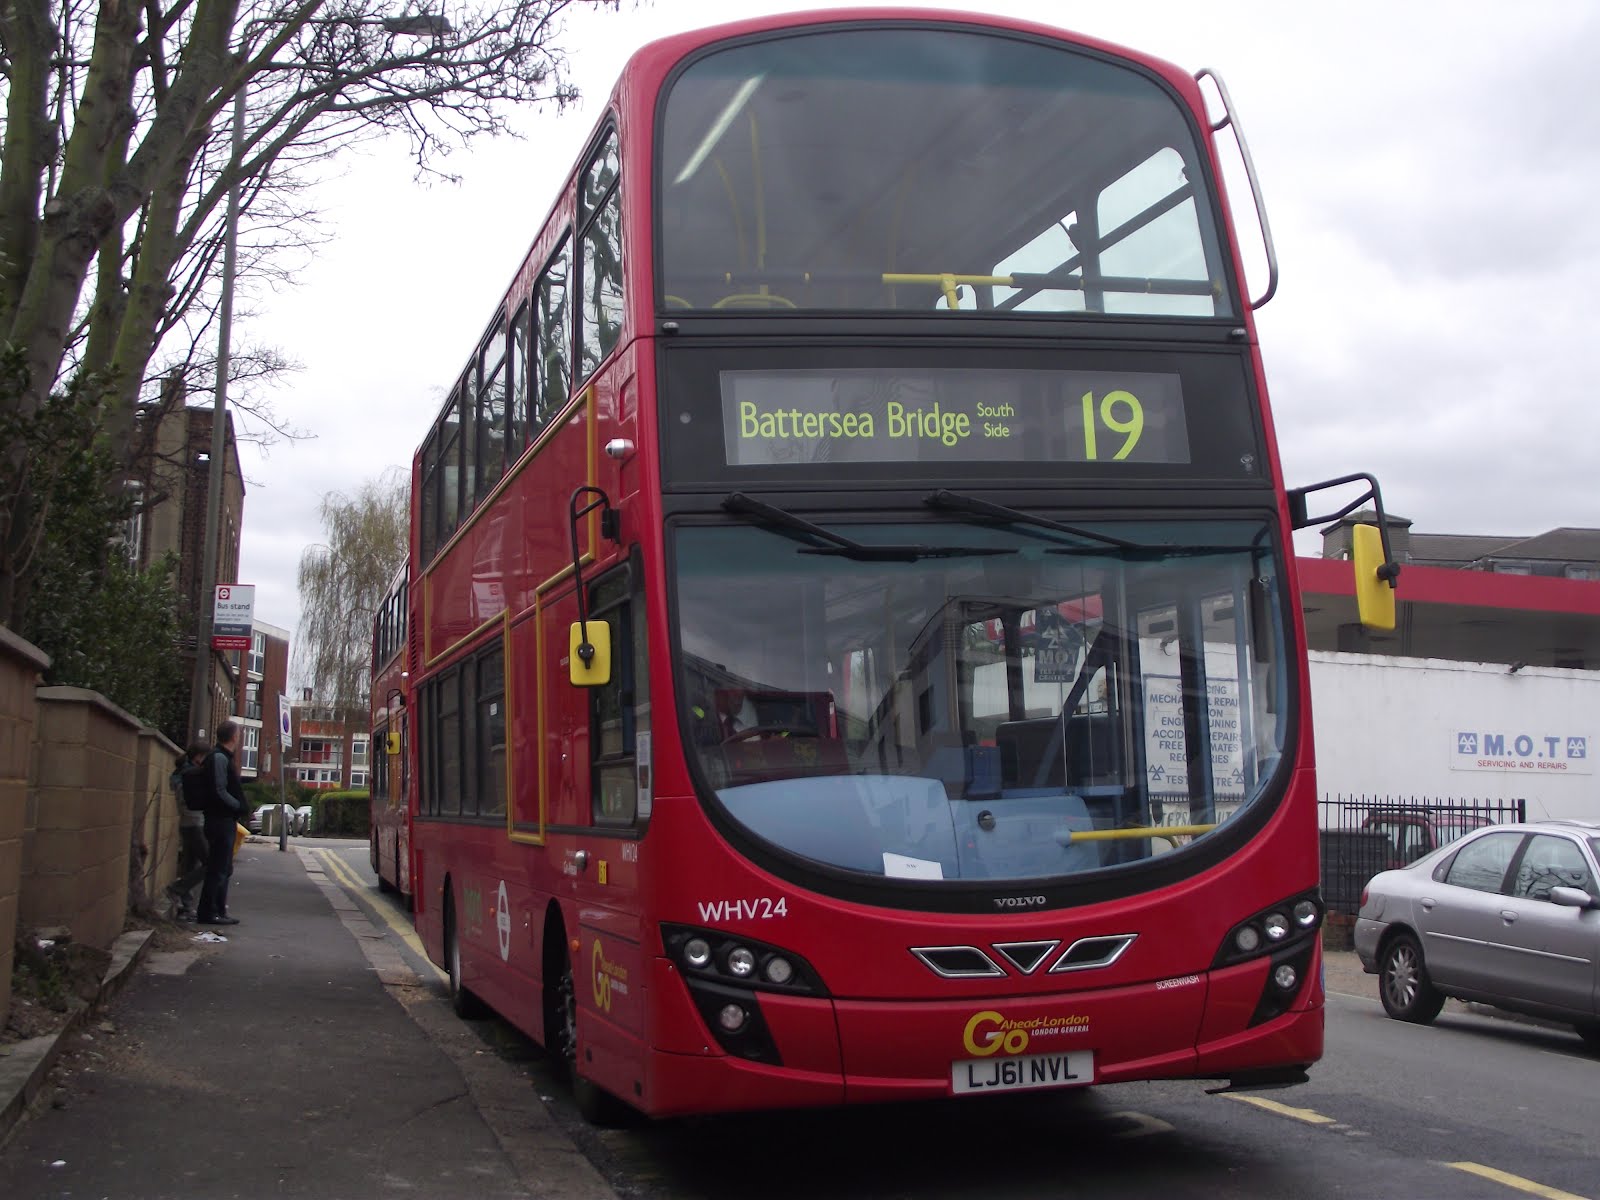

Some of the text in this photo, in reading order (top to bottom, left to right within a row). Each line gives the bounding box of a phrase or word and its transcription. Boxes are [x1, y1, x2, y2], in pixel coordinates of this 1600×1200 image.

[976, 402, 1015, 418] South
[740, 401, 970, 447] Battersea Bridge
[984, 421, 1010, 438] Side
[1081, 390, 1144, 460] 19
[217, 602, 229, 610] Bus
[1209, 719, 1237, 729] UNING
[1152, 730, 1185, 739] ACCID
[1159, 740, 1183, 750] FREE
[1484, 734, 1560, 758] M.O.T
[1477, 759, 1567, 770] SERVICING AND REPAIRS
[698, 896, 788, 923] WHV24
[993, 895, 1047, 909] VOLVO
[1155, 975, 1200, 990] SCREENWASH
[963, 1010, 1090, 1057] Go Ahead-London
[1031, 1025, 1089, 1036] LONDON GENERAL
[968, 1056, 1079, 1088] LJ61 NVL
